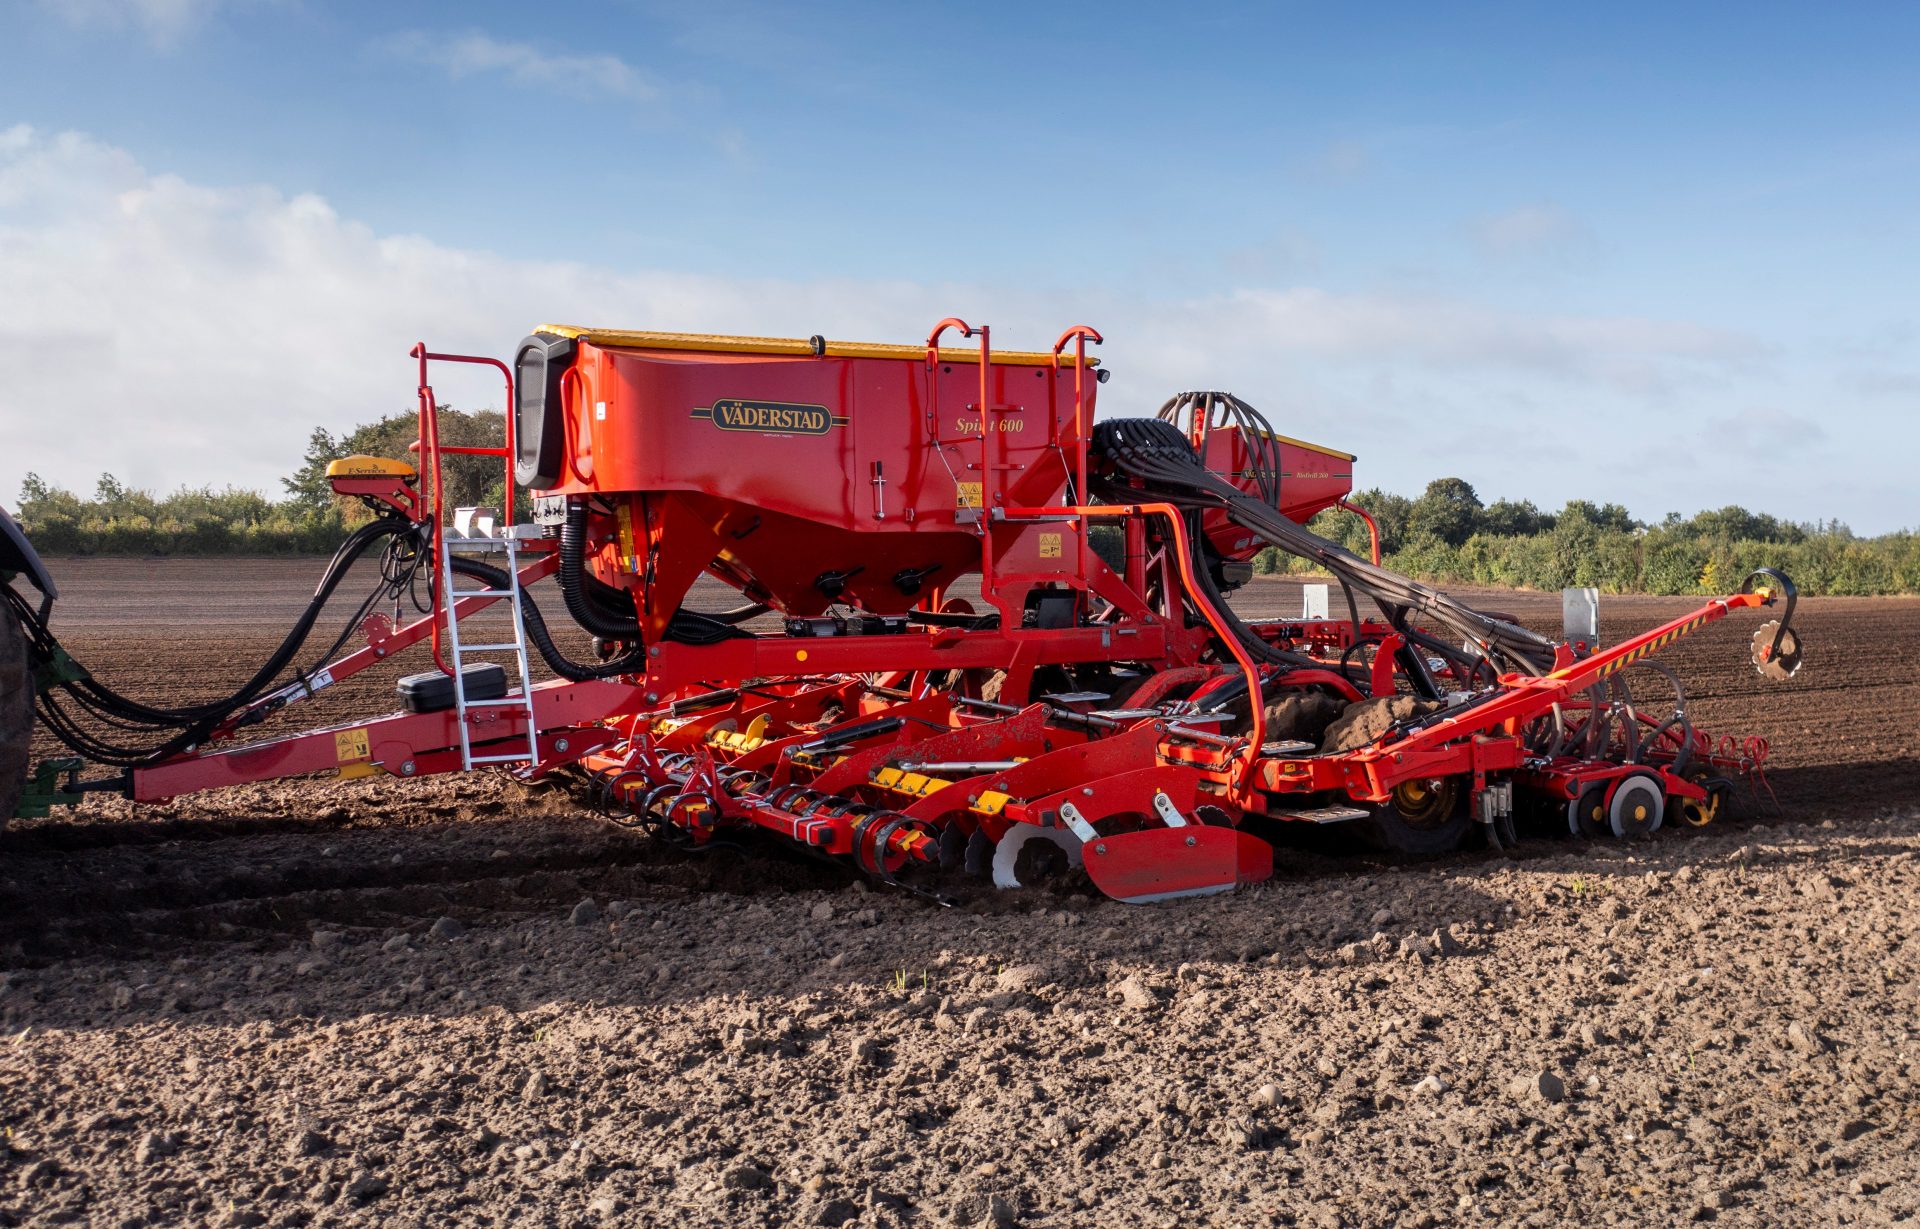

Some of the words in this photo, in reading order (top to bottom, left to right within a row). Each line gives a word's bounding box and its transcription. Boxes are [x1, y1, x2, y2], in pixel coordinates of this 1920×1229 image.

[721, 402, 824, 429] VÄDERSTAD
[956, 418, 995, 434] Spit
[1000, 419, 1024, 432] 600
